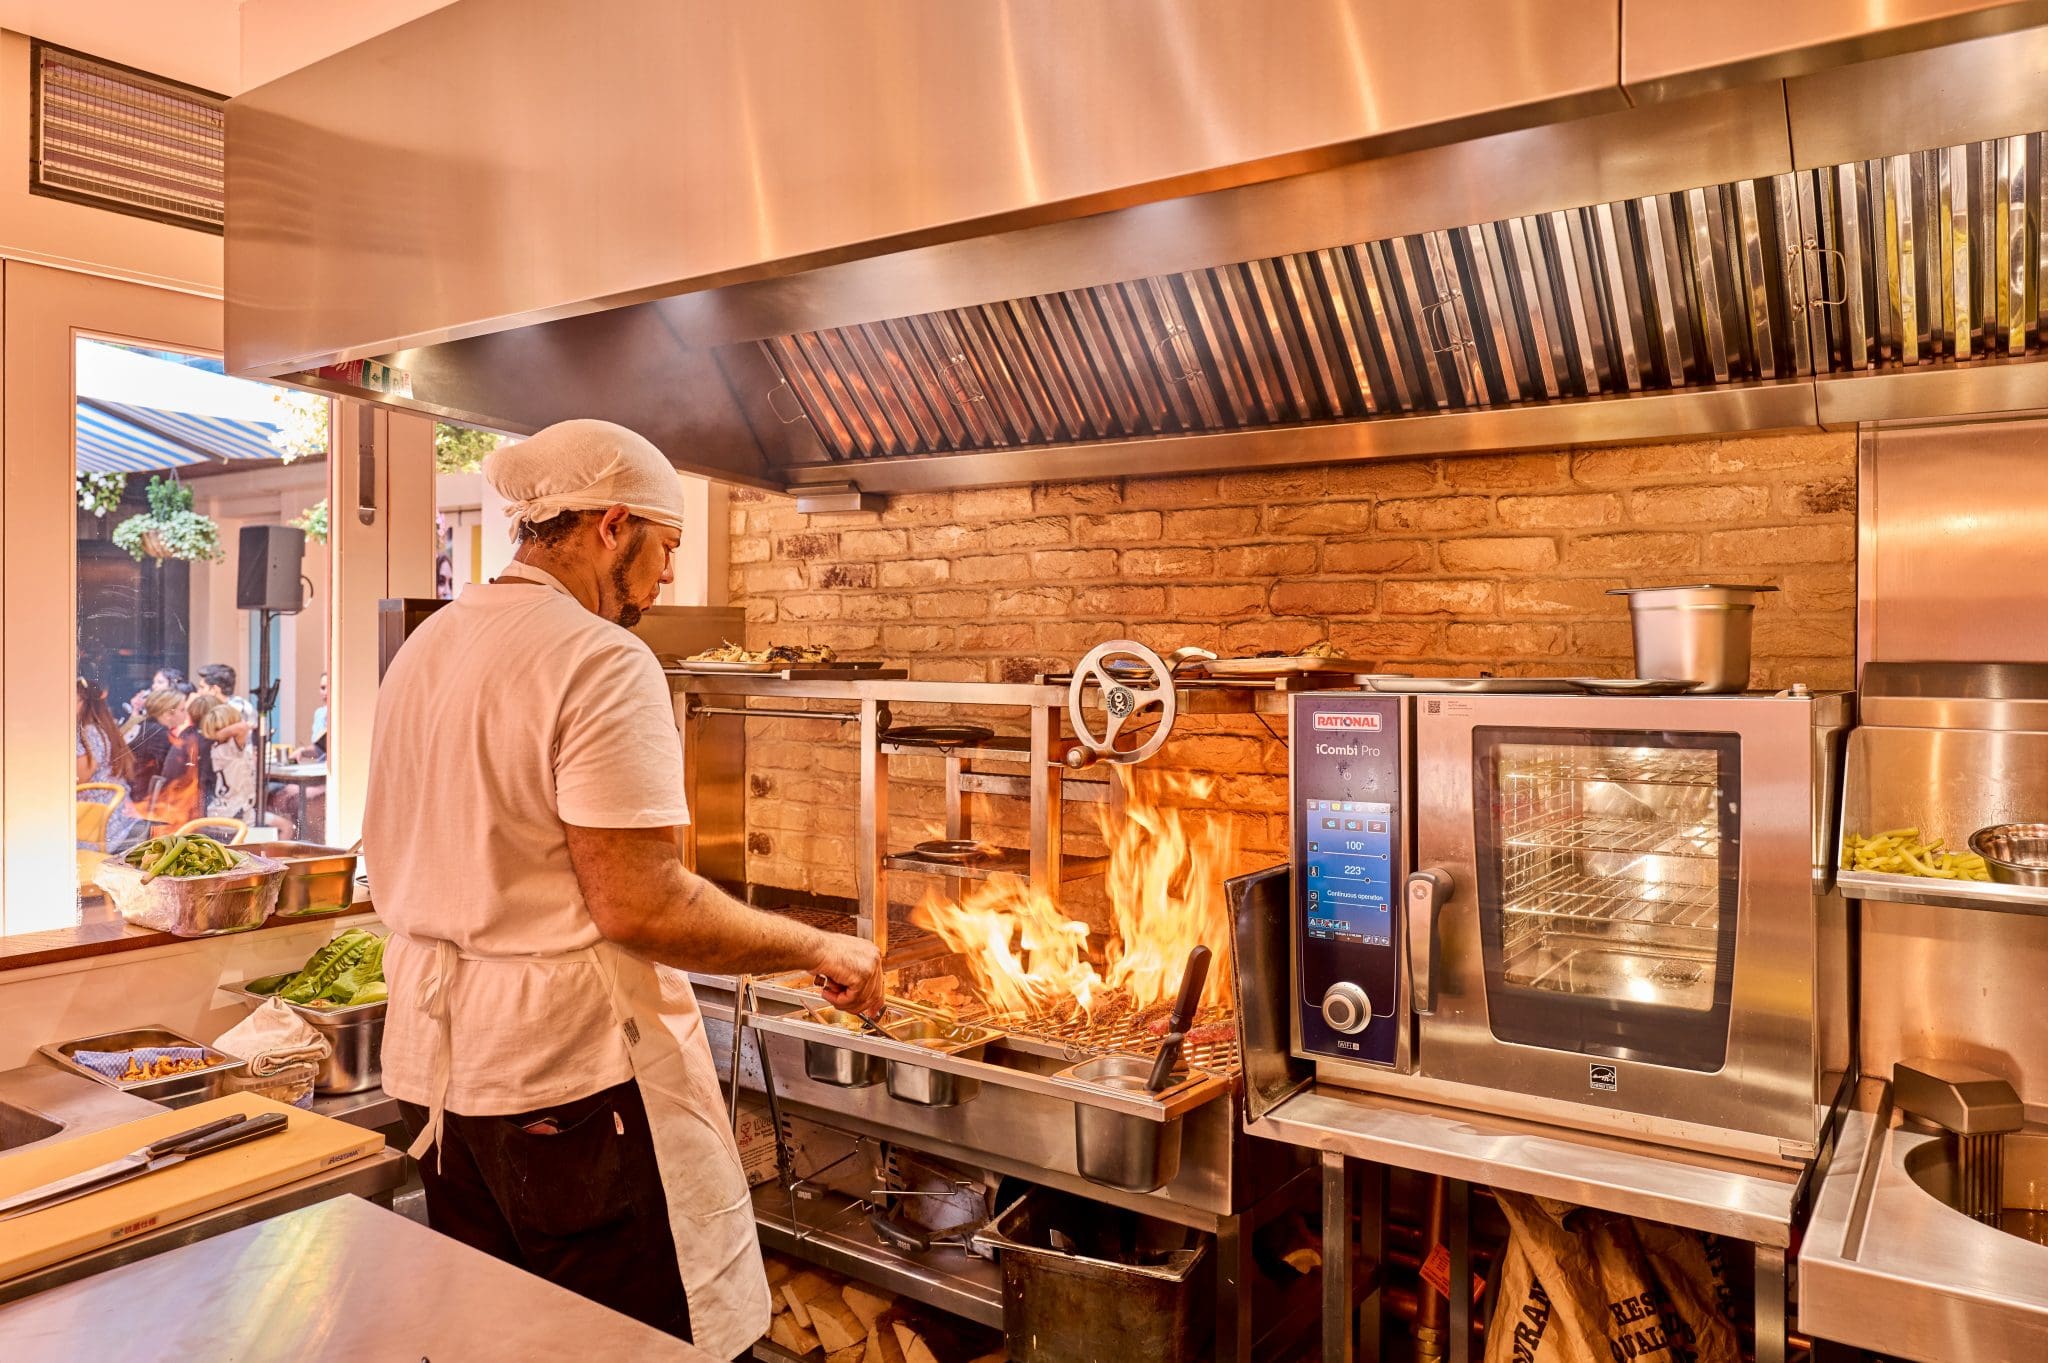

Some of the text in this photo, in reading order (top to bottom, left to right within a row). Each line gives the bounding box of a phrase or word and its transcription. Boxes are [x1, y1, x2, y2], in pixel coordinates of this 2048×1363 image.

[1317, 716, 1378, 728] RATIONAL
[1316, 744, 1381, 757] iCombi Pro
[1326, 889, 1384, 901] Continuous operation
